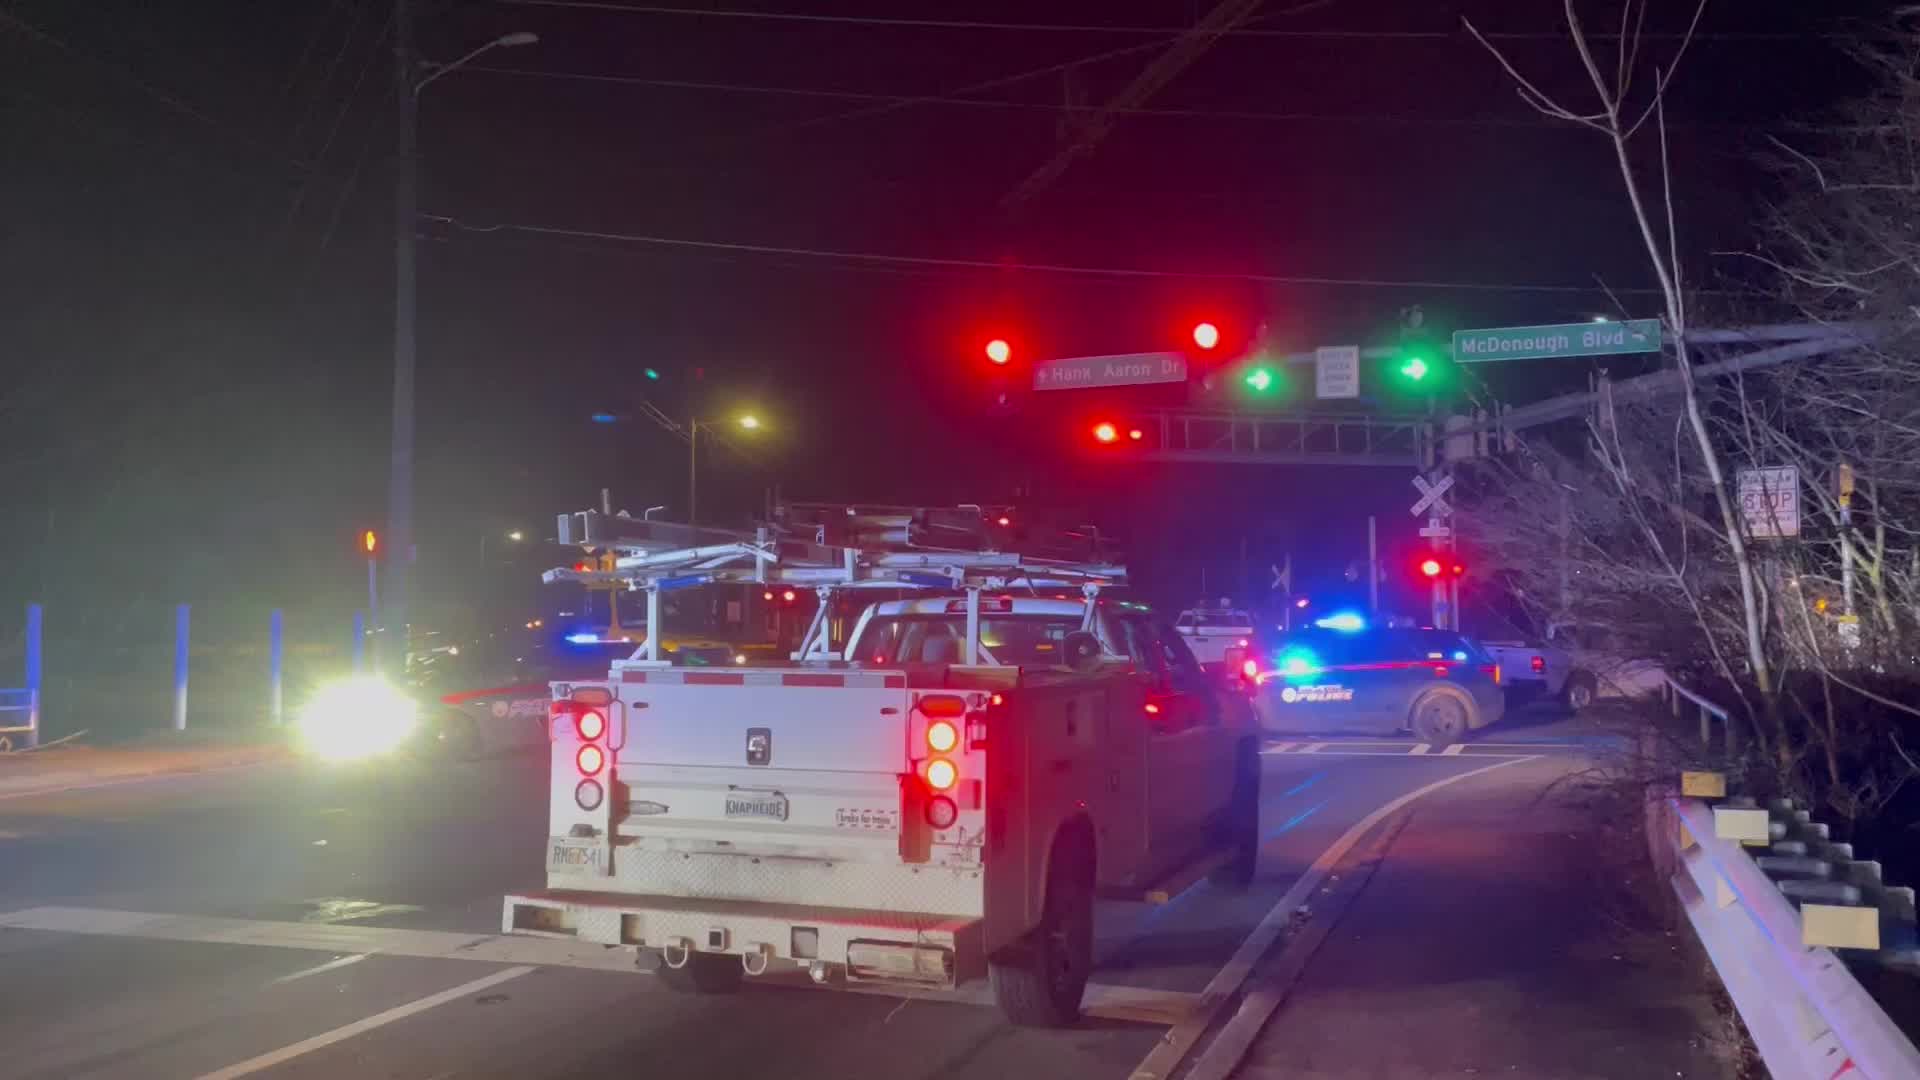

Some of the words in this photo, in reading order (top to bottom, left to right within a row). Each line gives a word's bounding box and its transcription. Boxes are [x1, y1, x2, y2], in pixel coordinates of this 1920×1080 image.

[1461, 335, 1569, 353] McDonough
[1583, 331, 1624, 347] Blvd
[1052, 367, 1092, 382] Hank
[1104, 362, 1152, 377] Aaron
[1161, 359, 1179, 374] Dr
[1744, 492, 1793, 510] STOP
[726, 799, 783, 817] KNAPHEIDE
